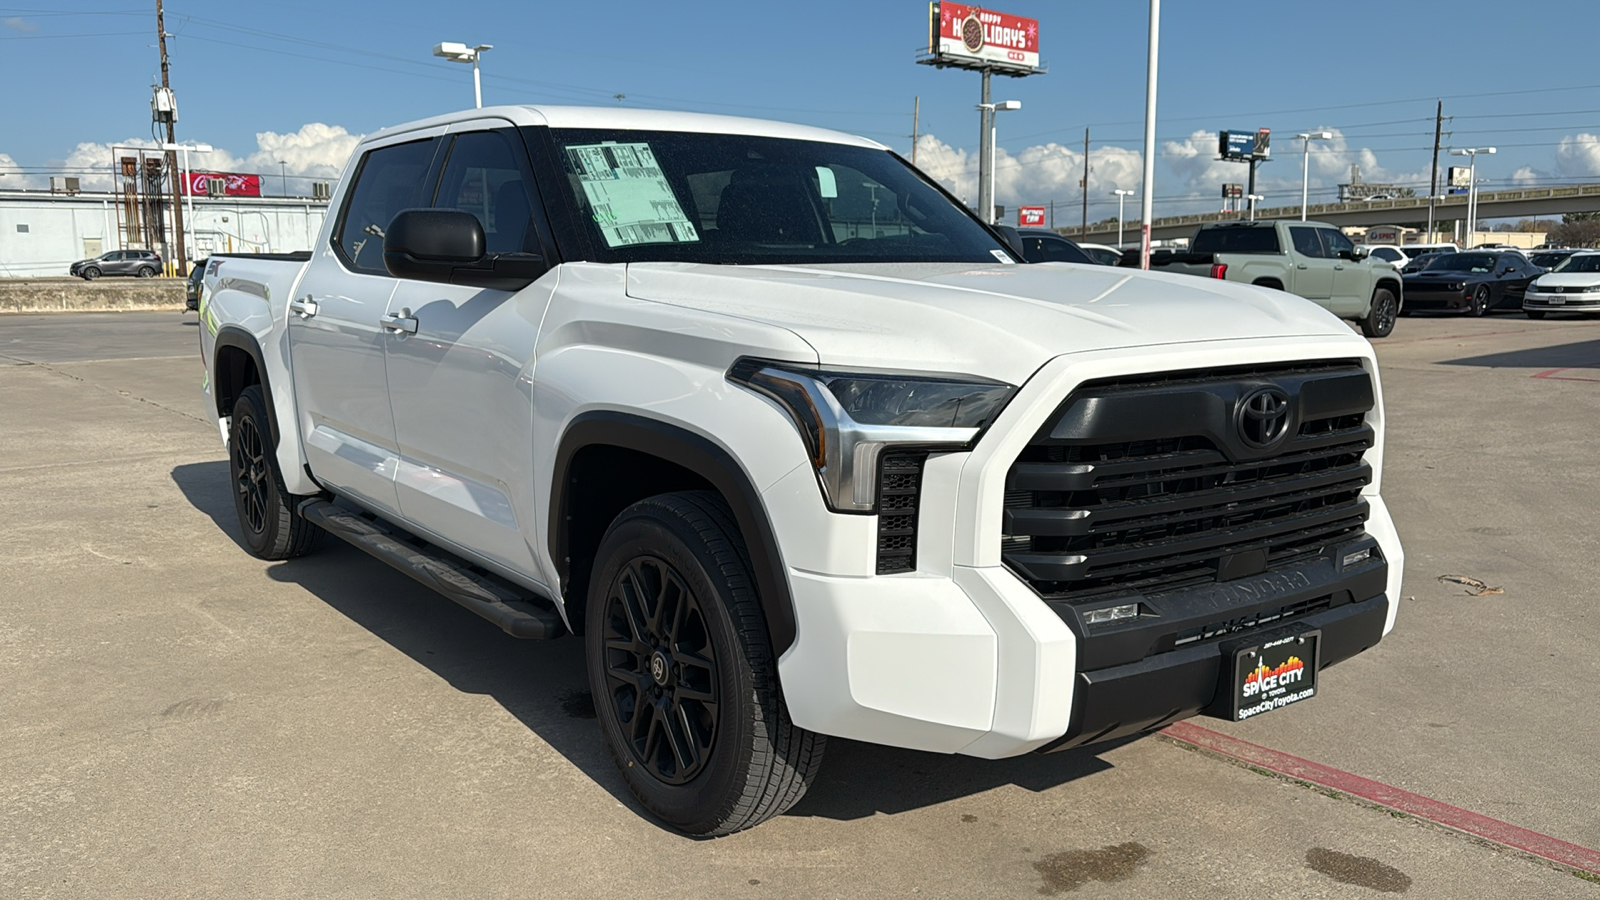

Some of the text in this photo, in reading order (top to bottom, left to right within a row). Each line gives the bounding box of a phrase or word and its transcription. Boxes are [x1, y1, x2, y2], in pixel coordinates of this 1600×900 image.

[980, 12, 1002, 25] HAPPY
[1208, 570, 1311, 609] TUNDRA
[1243, 667, 1304, 697] SPACE CITY
[1268, 687, 1287, 697] TOYOTA
[1238, 688, 1314, 719] SpaceCityToyota.com
